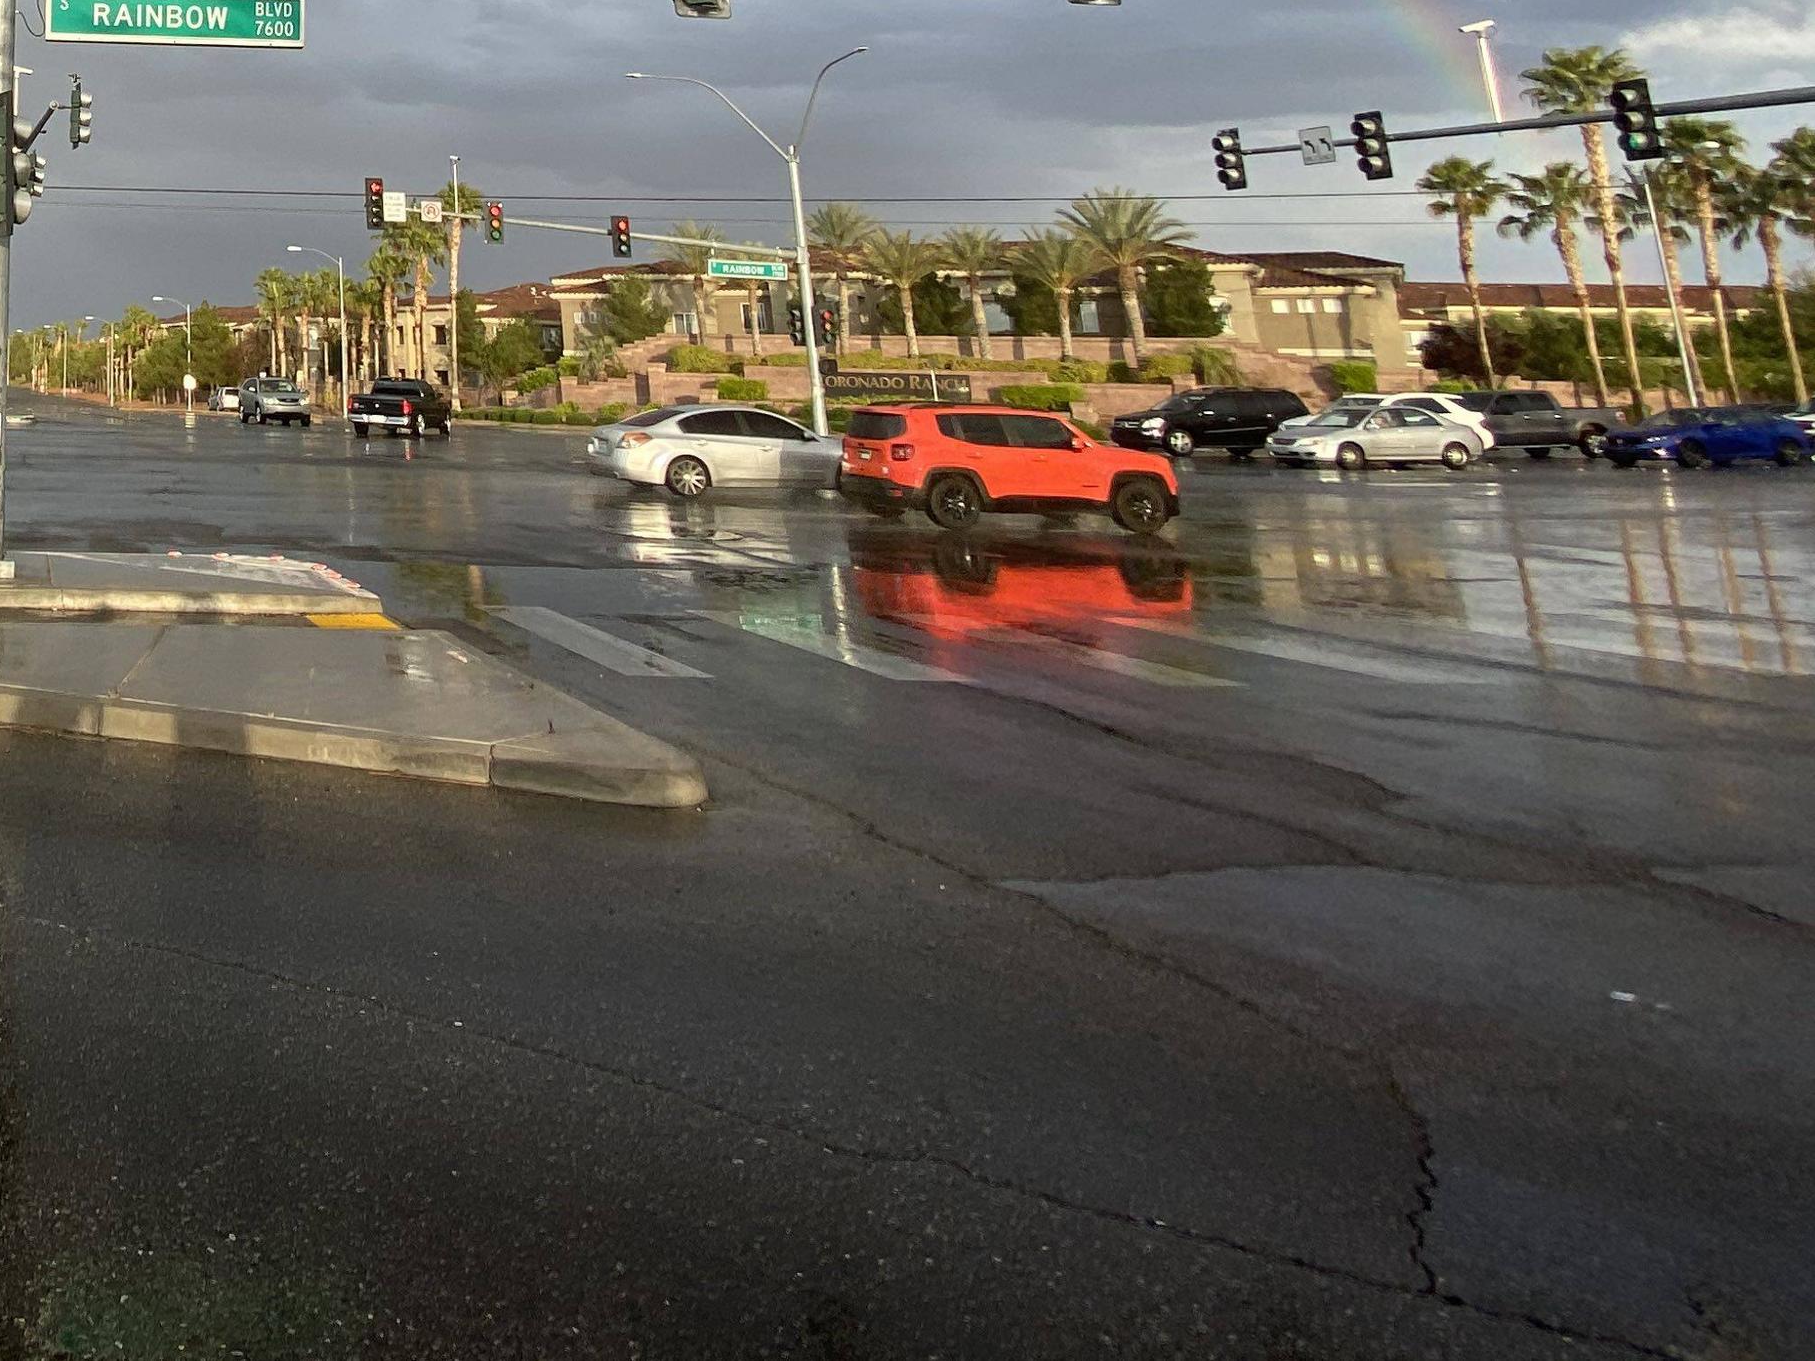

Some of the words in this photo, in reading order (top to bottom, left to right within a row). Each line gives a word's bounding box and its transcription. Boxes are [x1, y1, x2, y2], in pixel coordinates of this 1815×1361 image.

[93, 2, 228, 29] RAINBOW
[255, 2, 292, 18] BLVD
[255, 20, 294, 36] 7600
[824, 375, 904, 389] ORONADO
